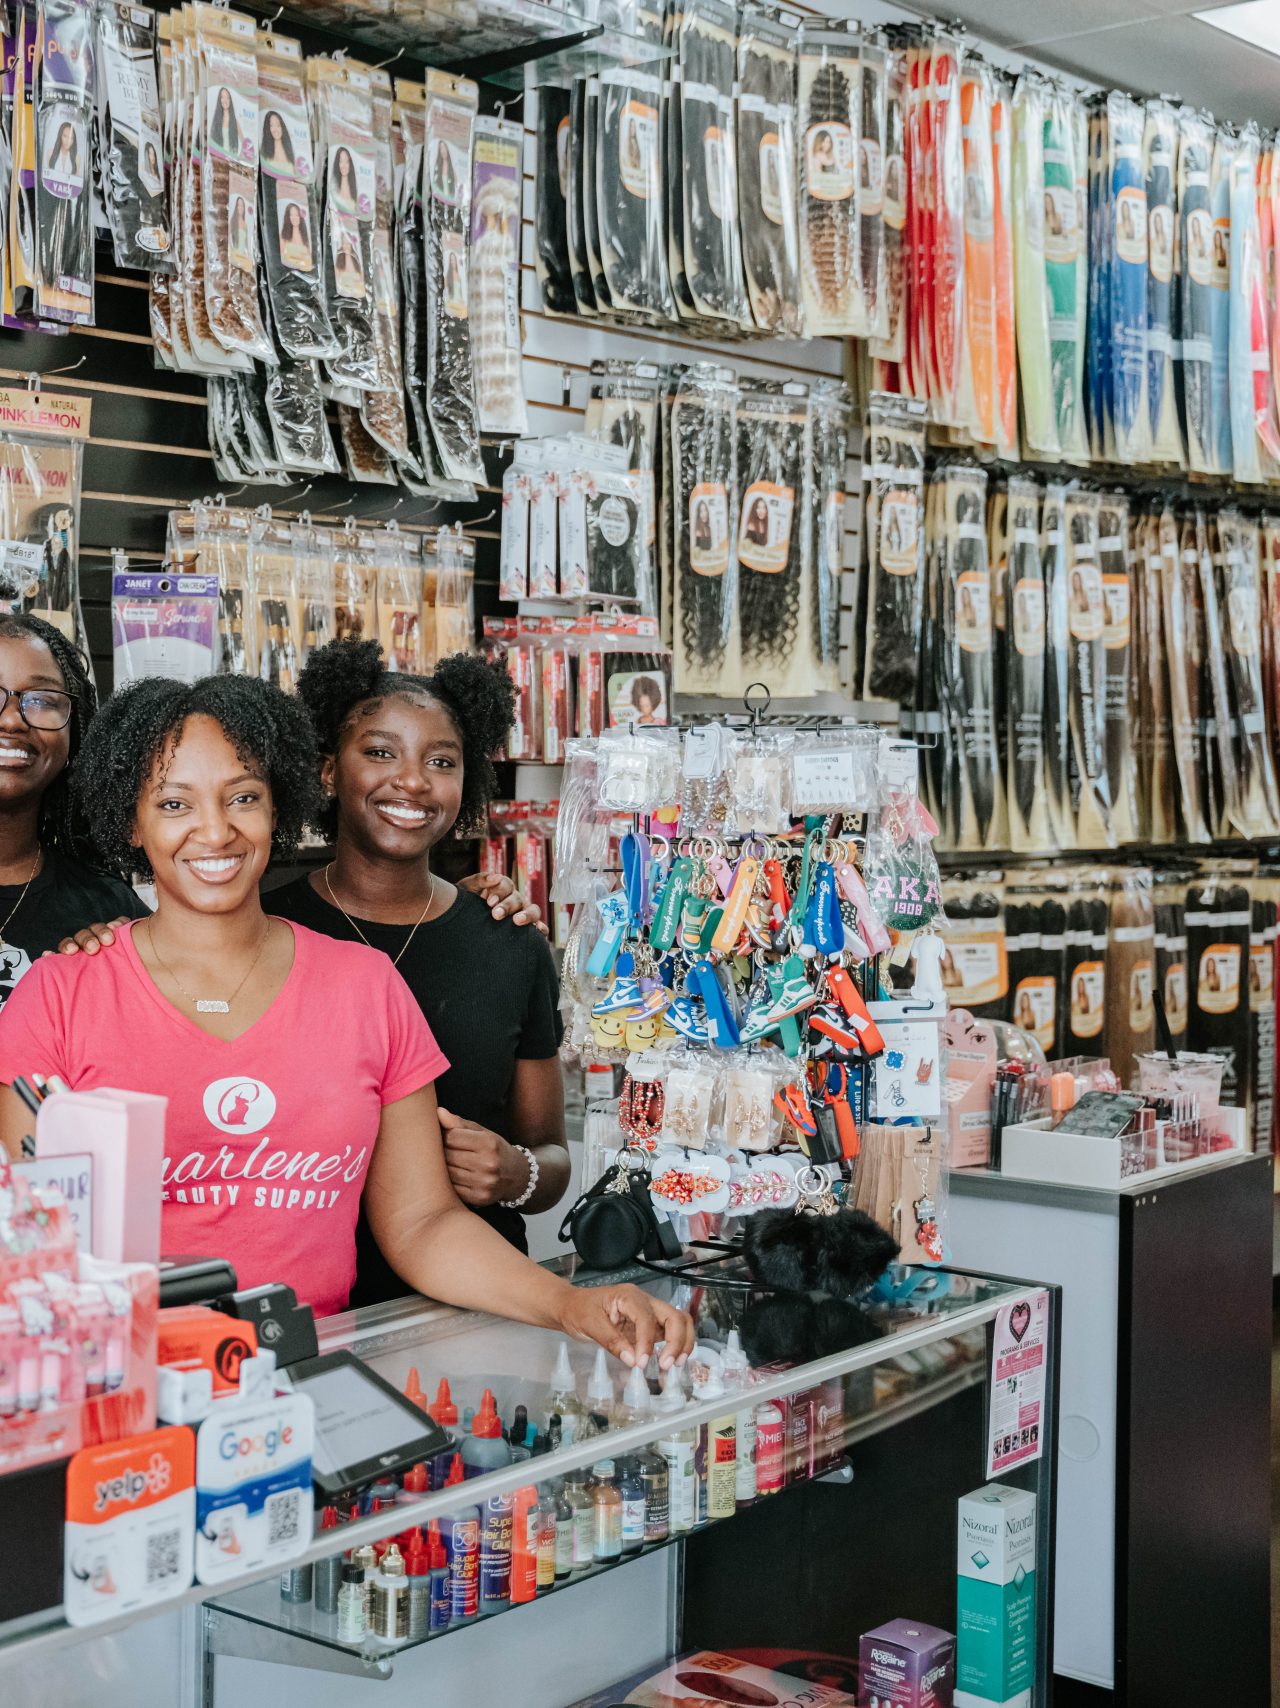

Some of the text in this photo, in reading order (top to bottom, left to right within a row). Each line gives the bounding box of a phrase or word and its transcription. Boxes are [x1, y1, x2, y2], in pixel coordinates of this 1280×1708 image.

[51, 400, 78, 411] NATURAL
[29, 408, 81, 429] LEMON
[125, 579, 152, 589] JANET
[873, 876, 940, 905] AKA
[254, 1186, 341, 1209] SUPPLY
[1000, 1344, 1020, 1356] PROGRAMS
[1023, 1337, 1040, 1349] SERVICES
[220, 1420, 293, 1461] Google
[96, 1469, 147, 1510] yelp
[962, 1516, 998, 1536] Nizoral
[1005, 1508, 1035, 1538] Nizoral
[870, 1649, 907, 1668] Rogaine
[921, 1665, 947, 1690] Rogaine
